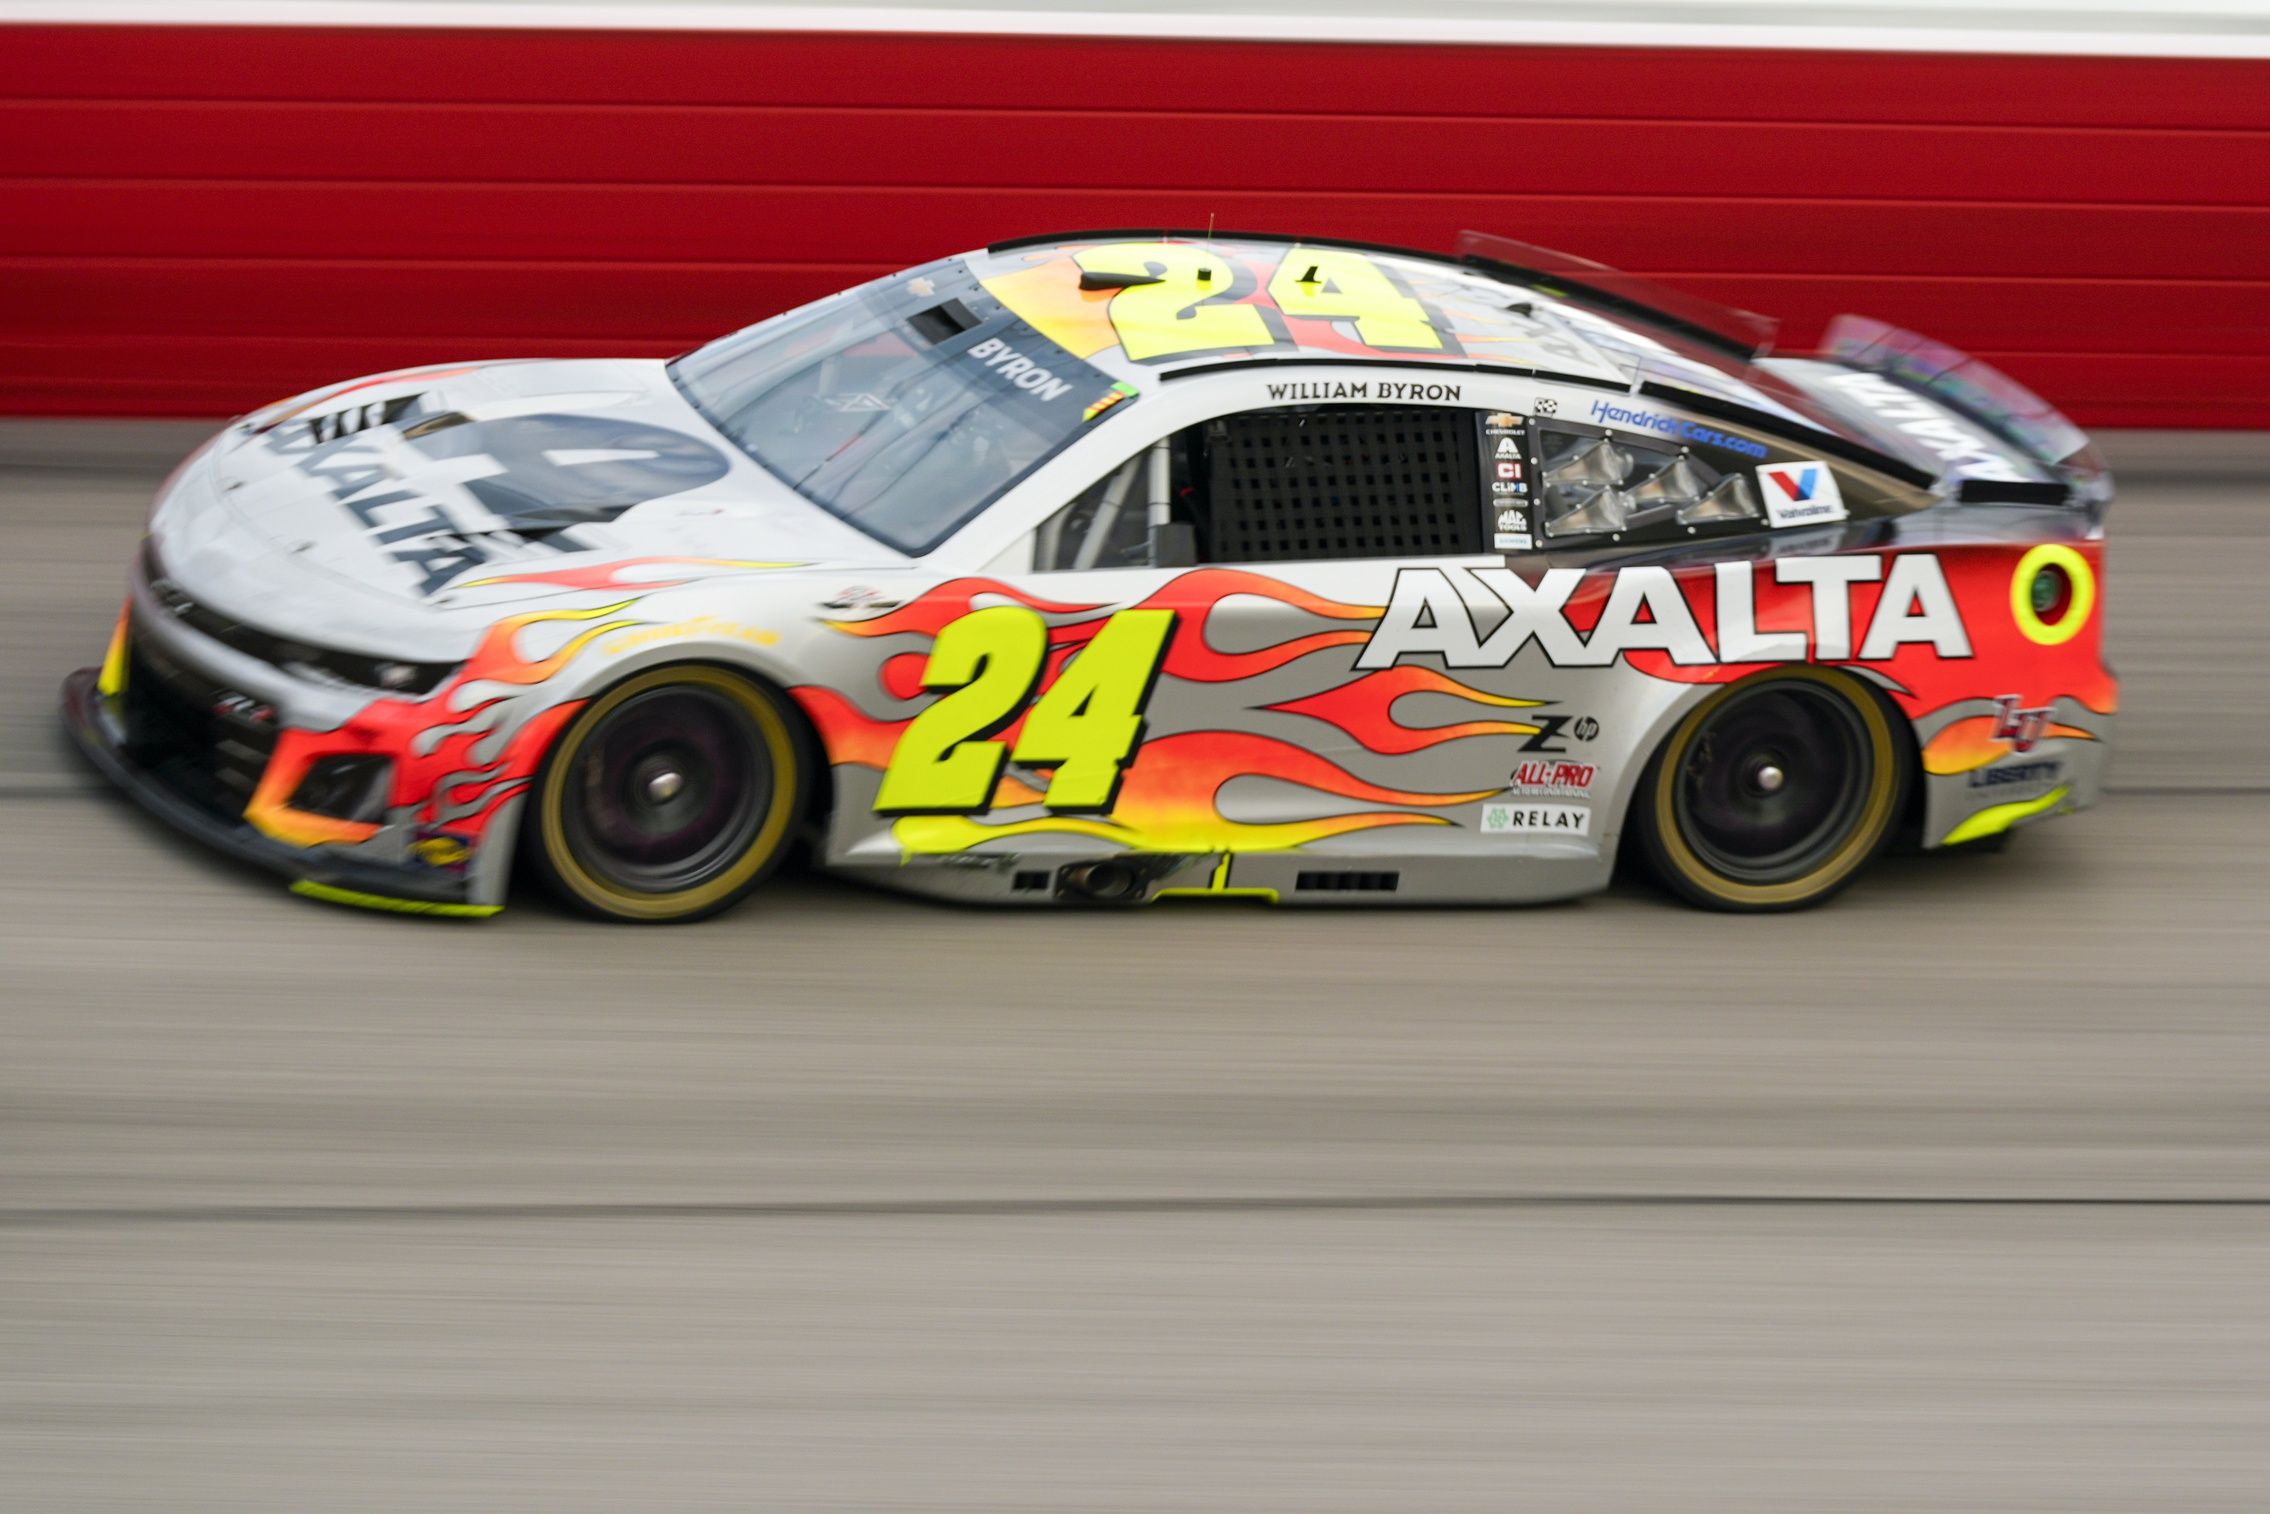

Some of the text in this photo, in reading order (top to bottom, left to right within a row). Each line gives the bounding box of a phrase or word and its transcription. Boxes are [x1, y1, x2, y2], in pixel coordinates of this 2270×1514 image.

[1072, 242, 1450, 363] 24
[967, 338, 1074, 401] BYRON
[1267, 382, 1461, 401] WILLIAM BYRON
[1498, 463, 1521, 479] CI
[1350, 553, 1974, 671] AXALTA
[872, 605, 1182, 817] 24
[1511, 761, 1595, 789] ALL-PRO
[1513, 810, 1585, 829] RELAY
